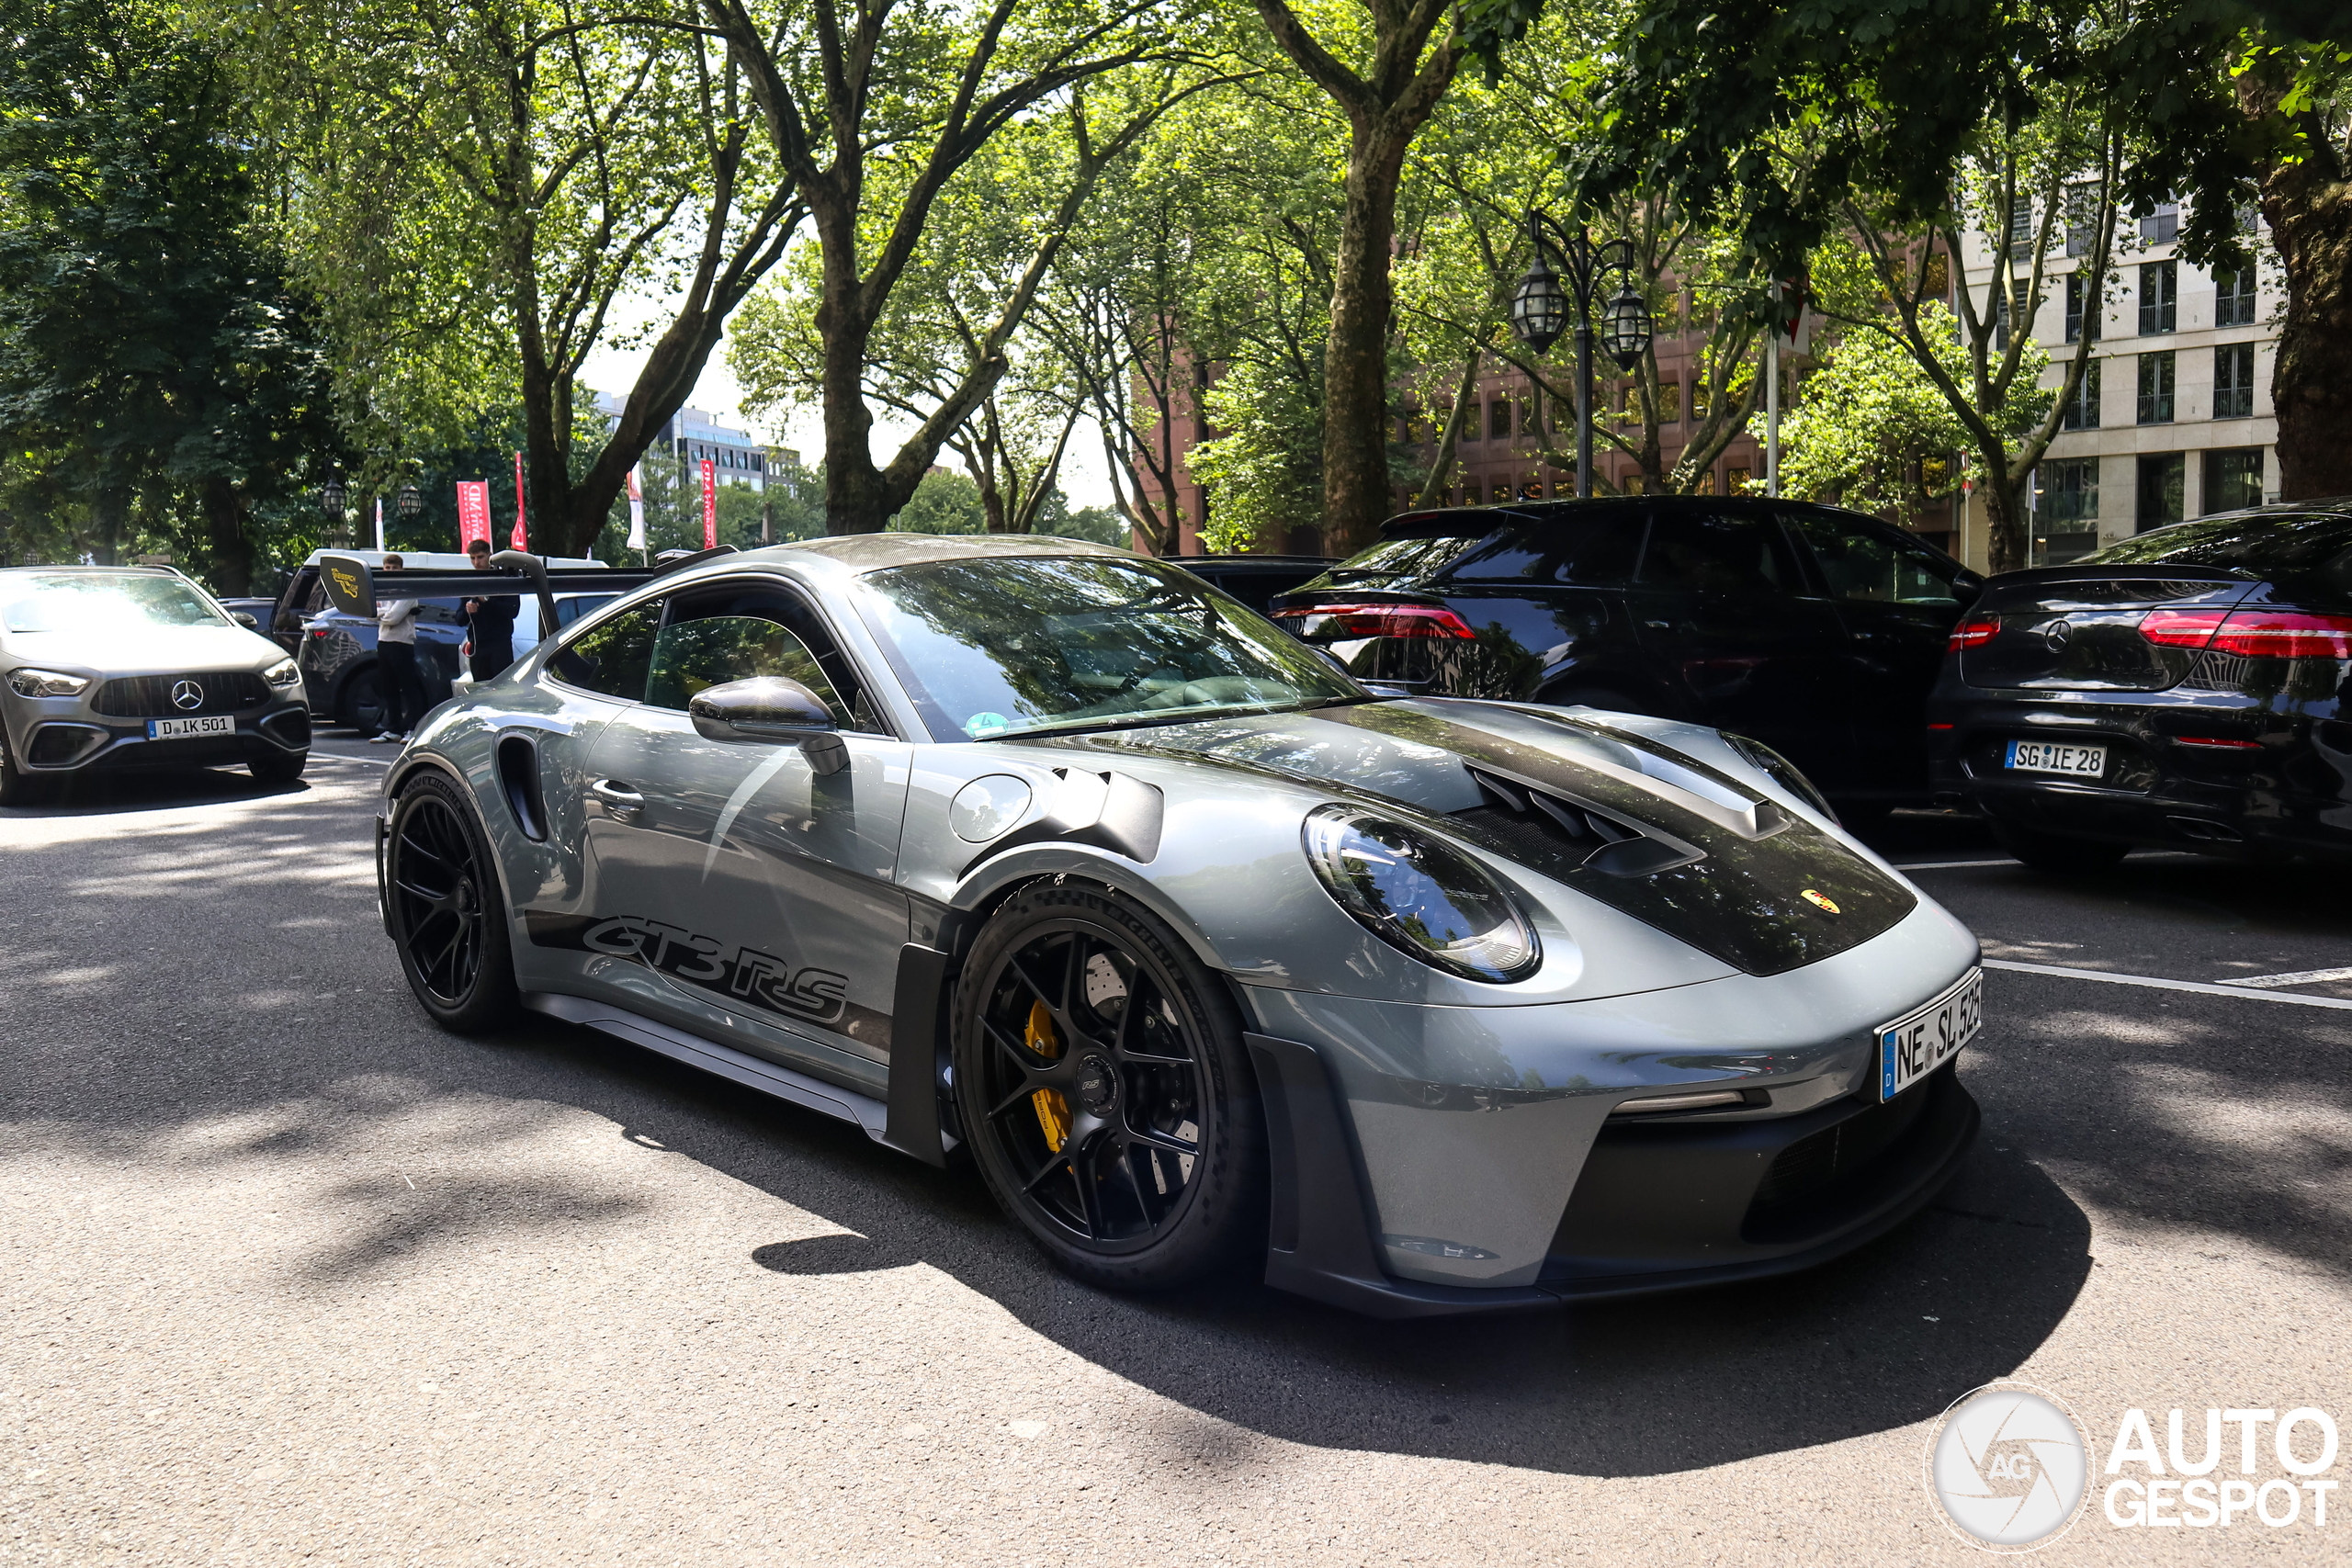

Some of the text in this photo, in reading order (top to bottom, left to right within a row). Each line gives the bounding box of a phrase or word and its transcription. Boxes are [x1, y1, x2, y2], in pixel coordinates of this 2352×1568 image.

[163, 717, 228, 735] D IK 501
[981, 715, 993, 726] 4
[2017, 745, 2101, 772] SG IE 28
[429, 777, 462, 809] MICHELIN
[1106, 907, 1183, 981] MICHELIN
[1184, 989, 1204, 1019] PILOT
[1201, 1024, 1217, 1062] SPORT
[1213, 1066, 1223, 1090] CUP
[1897, 981, 1980, 1084] NE SL 525
[1082, 1079, 1100, 1090] RS
[1885, 1073, 1891, 1087] D
[1035, 1092, 1048, 1129] PORS
